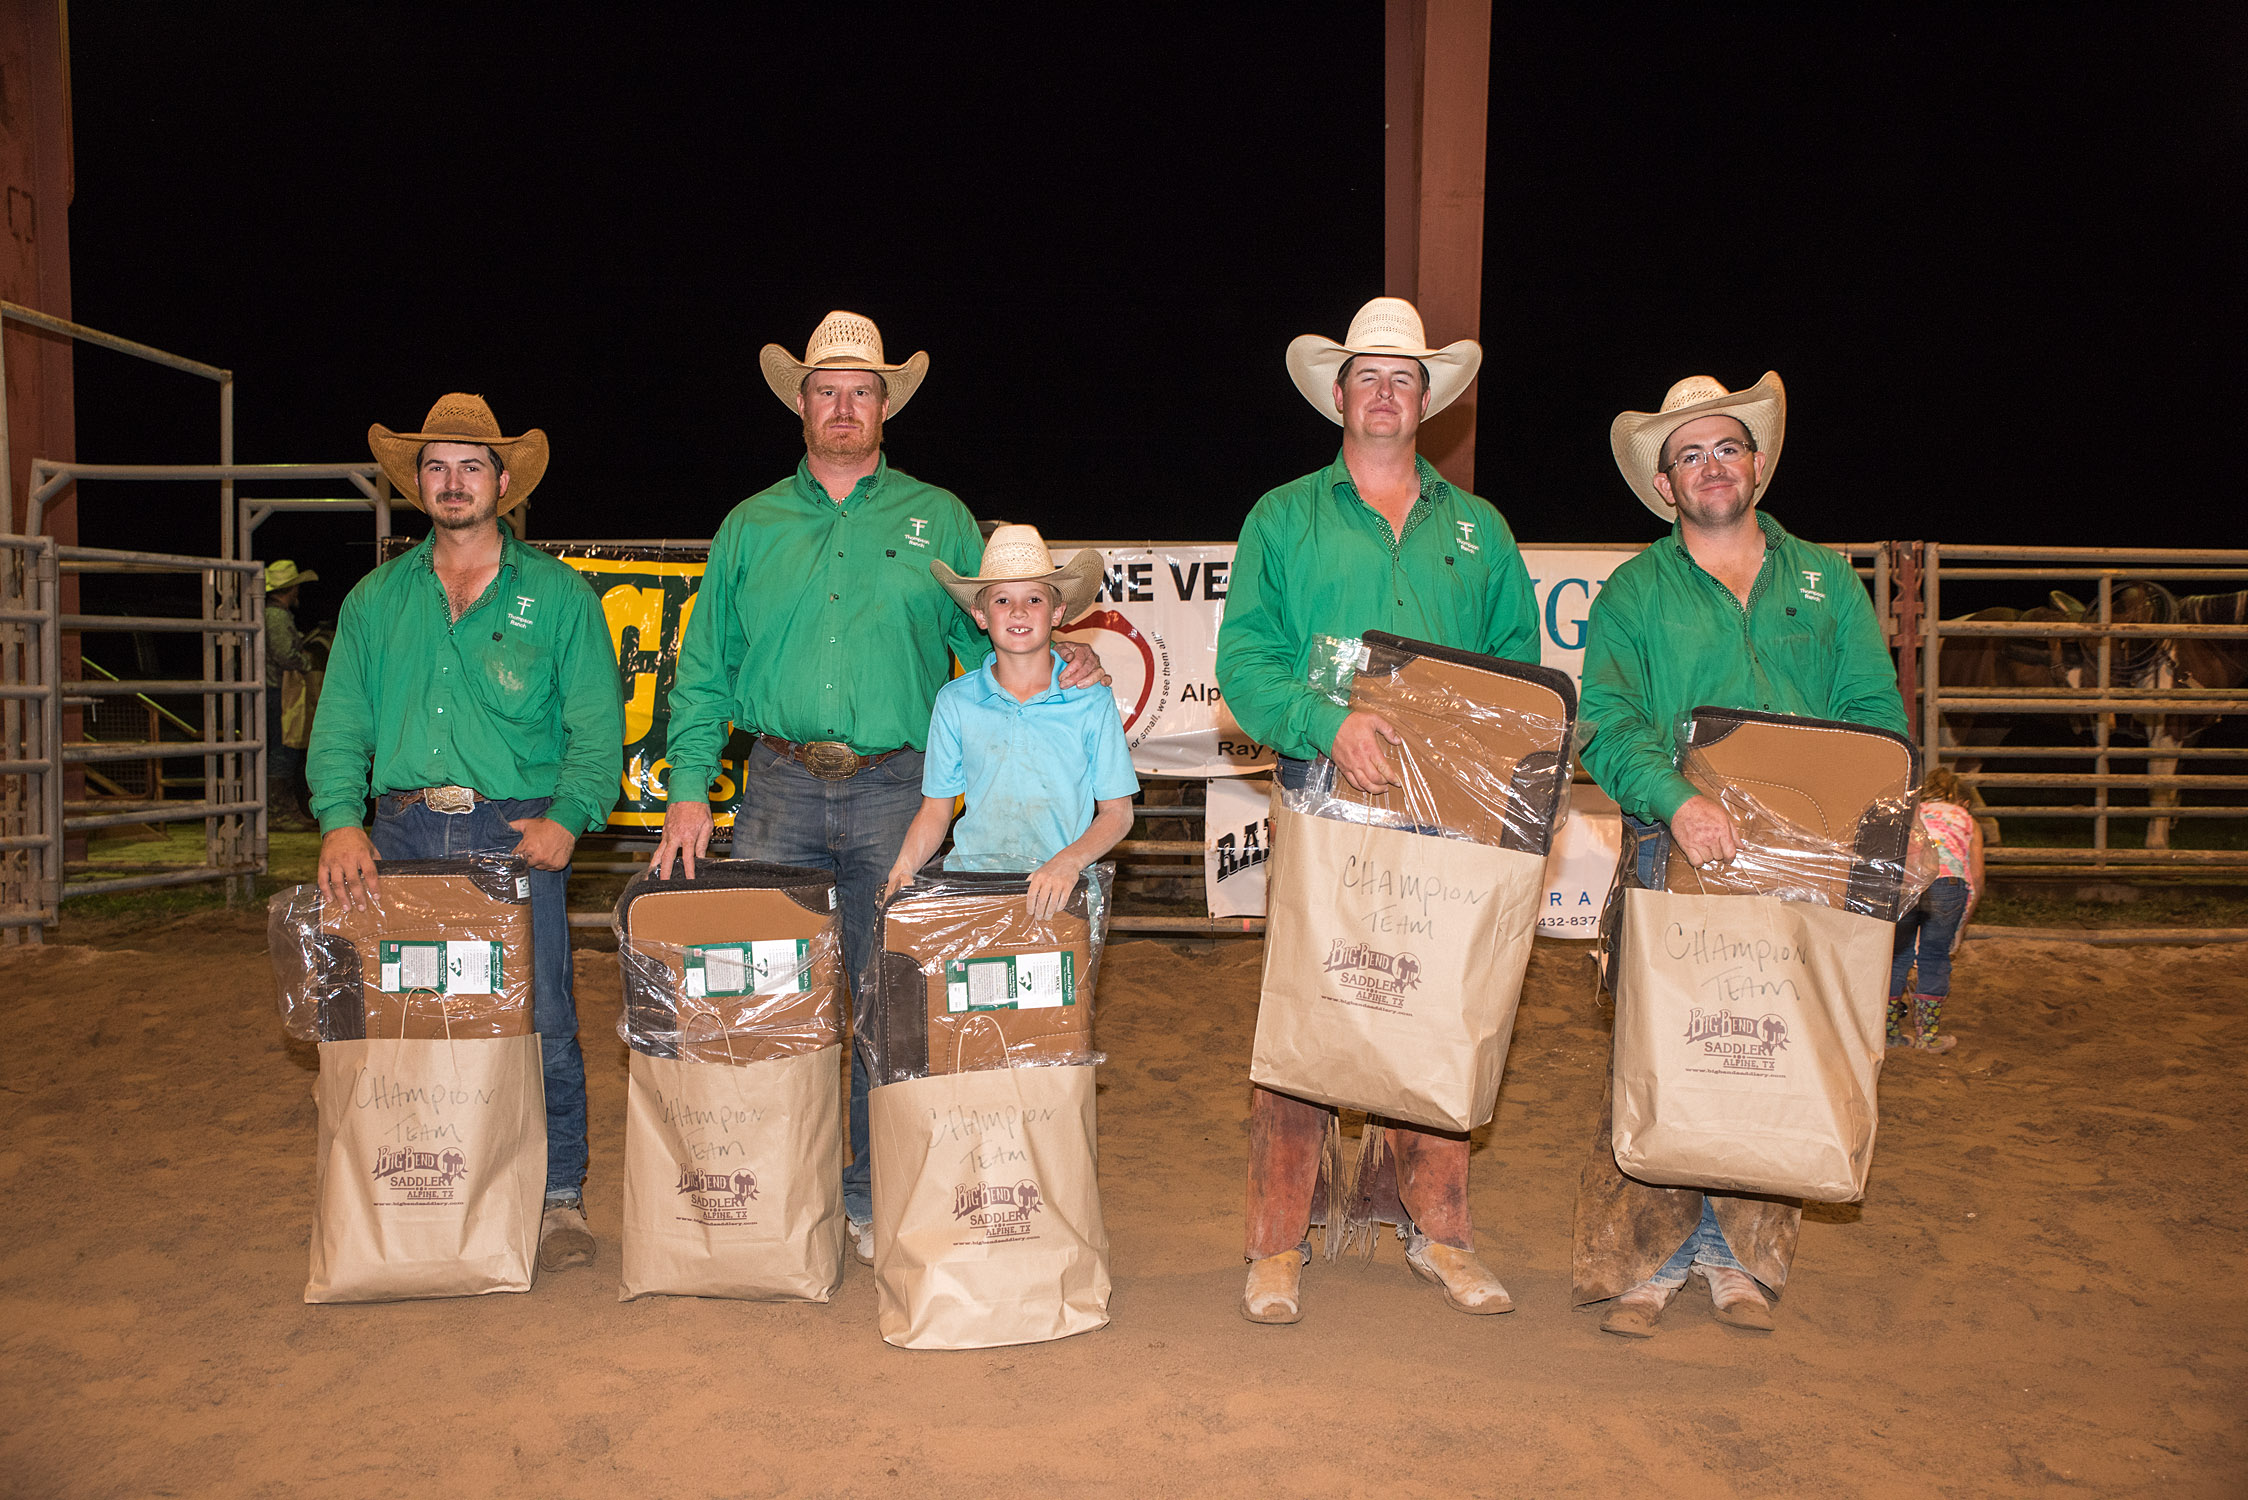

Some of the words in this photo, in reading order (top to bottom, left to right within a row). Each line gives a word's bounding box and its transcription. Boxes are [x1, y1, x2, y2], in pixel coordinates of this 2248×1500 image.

[904, 534, 930, 545] Thompson
[908, 540, 925, 549] Ranch
[1456, 537, 1479, 550] Thompson
[1461, 545, 1475, 554] Ranch
[1092, 562, 1154, 602] NE
[1168, 561, 1235, 602] VE
[1800, 588, 1826, 599] Thompson
[1804, 594, 1821, 602] Ranch
[508, 613, 533, 625] Thompson
[510, 619, 527, 629] Ranch
[1161, 652, 1171, 677] them
[1162, 679, 1171, 697] see
[1180, 683, 1221, 707] Alp
[1157, 698, 1167, 712] we
[1131, 738, 1140, 748] or
[1217, 741, 1264, 760] Ray
[1537, 916, 1600, 927] 432-837-
[1340, 972, 1406, 994] SADDLERY
[1355, 991, 1389, 1004] ALPINE,
[1392, 997, 1405, 1007] TX
[1704, 1041, 1776, 1056] SADDLERY
[1723, 1058, 1759, 1069] ALPINE,
[1762, 1061, 1776, 1069] TX
[390, 1176, 454, 1187] SADDLERY
[407, 1190, 440, 1198] ALPINE,
[442, 1190, 454, 1198] TX
[691, 1193, 746, 1208] SADDLERY
[702, 1211, 733, 1219] ALPINE,
[969, 1207, 1031, 1226] SADDLERY
[985, 1226, 1017, 1237] ALPINE,
[1020, 1224, 1032, 1233] TX
